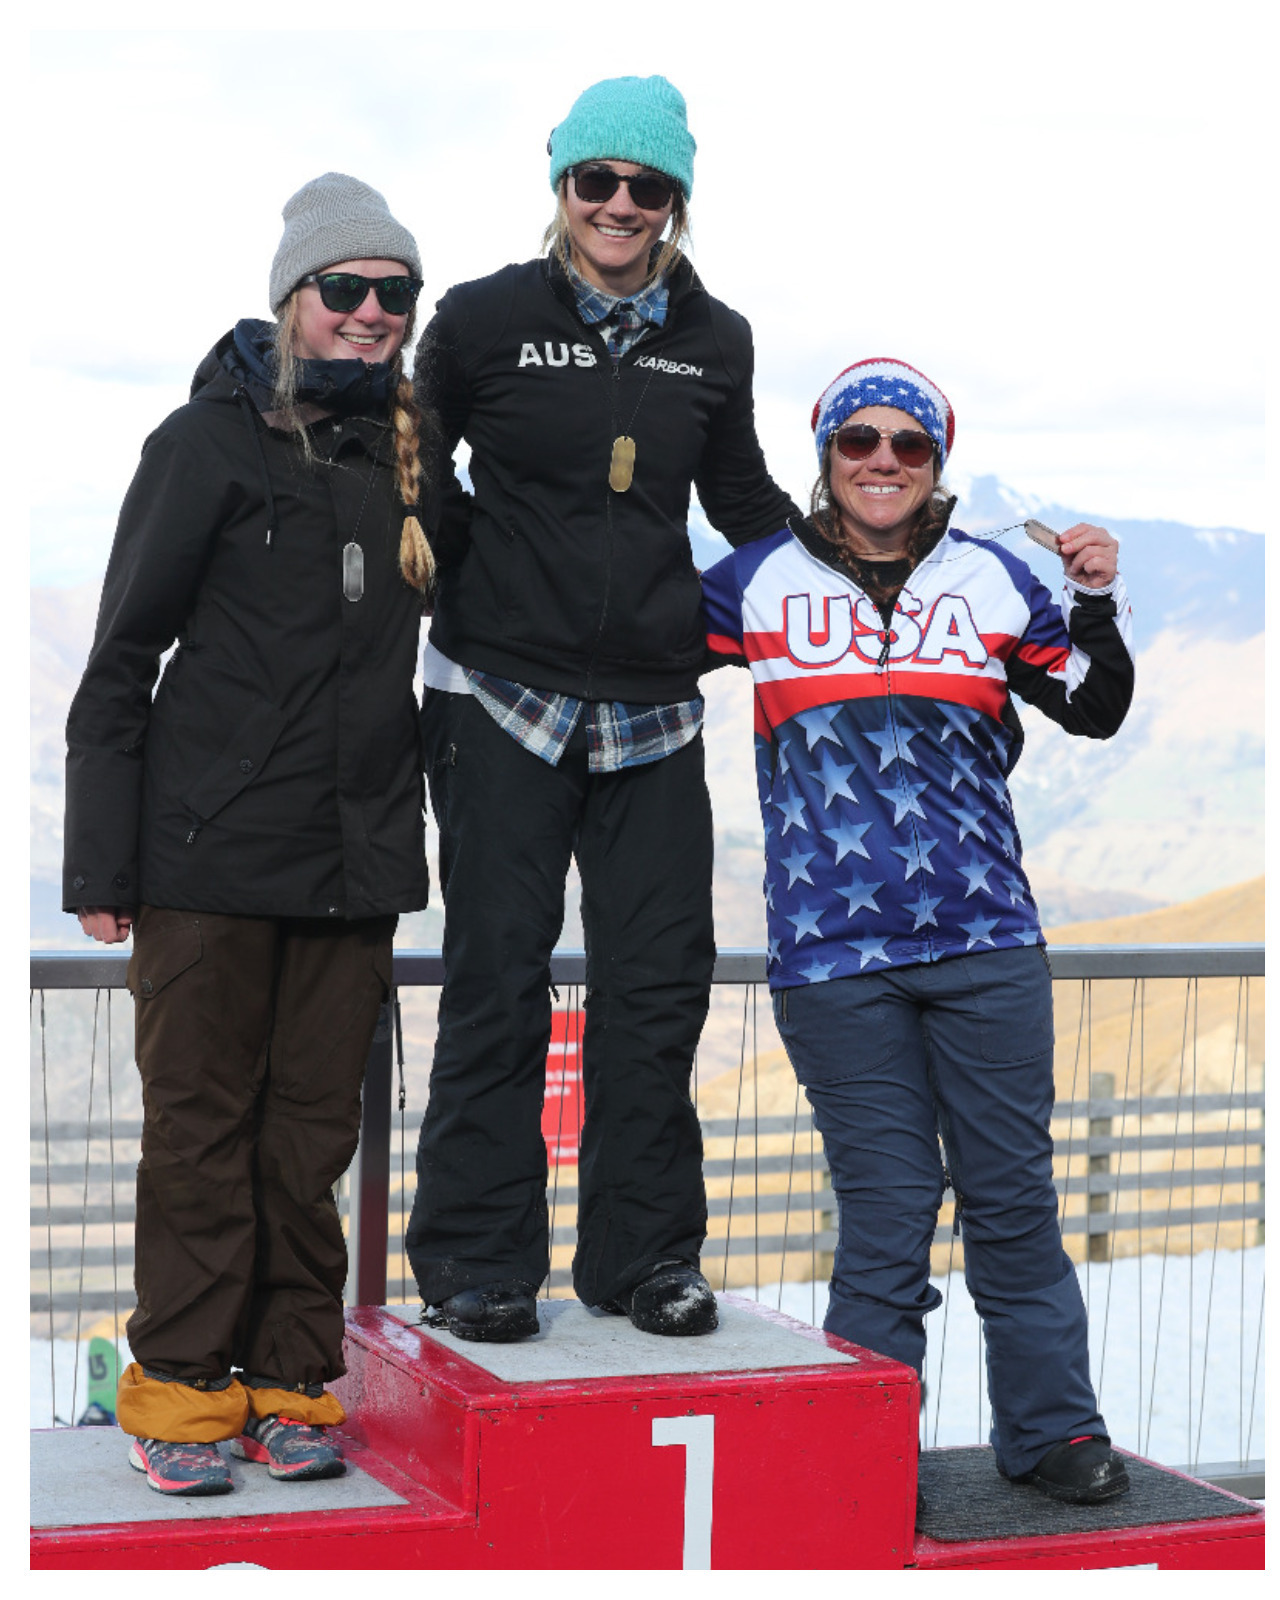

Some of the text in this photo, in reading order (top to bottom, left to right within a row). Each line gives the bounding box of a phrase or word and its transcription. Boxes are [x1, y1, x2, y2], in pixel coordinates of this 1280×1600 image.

[518, 341, 597, 368] AUS
[633, 355, 704, 377] KARBON
[782, 592, 989, 669] USA
[652, 1414, 715, 1570] 1
